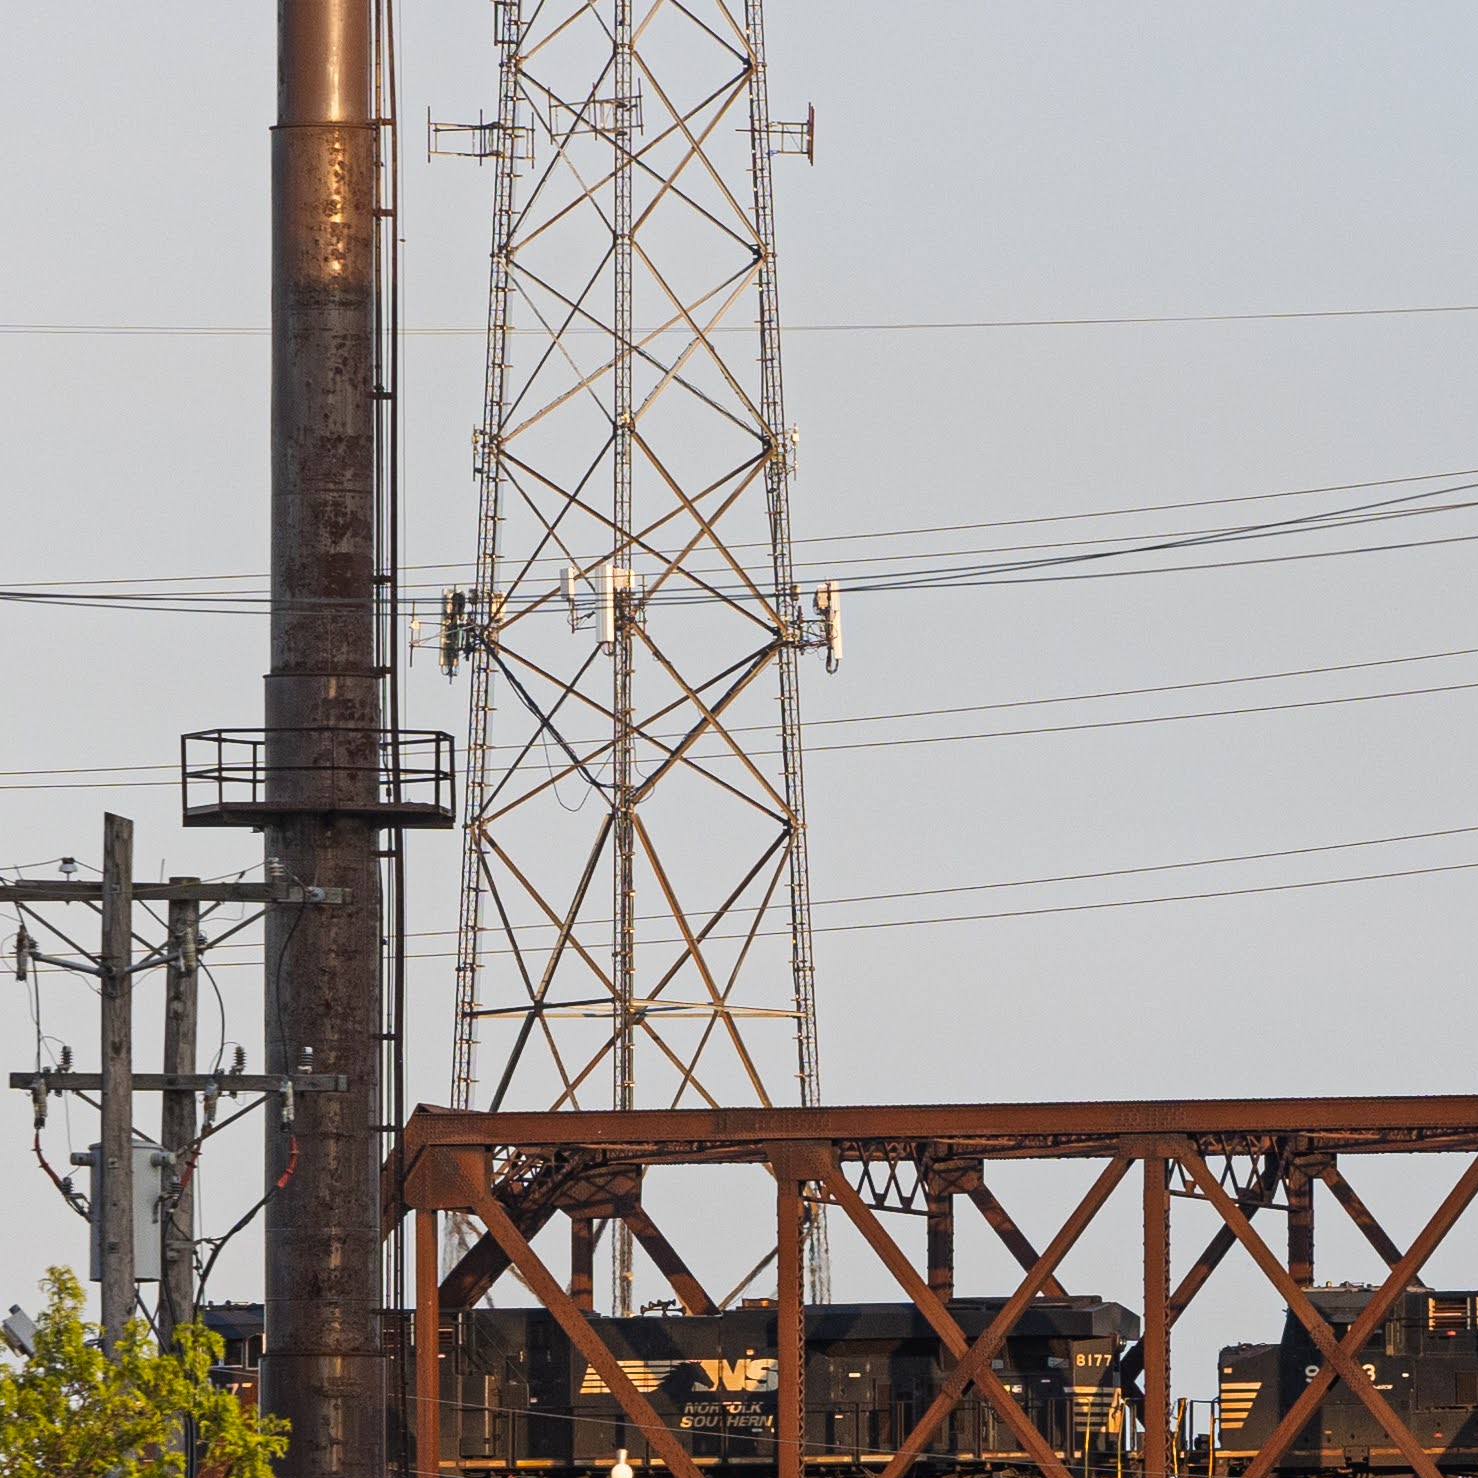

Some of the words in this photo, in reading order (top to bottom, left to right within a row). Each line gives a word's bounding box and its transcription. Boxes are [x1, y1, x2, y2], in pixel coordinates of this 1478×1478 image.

[1076, 1353, 1112, 1367] 8177
[692, 1359, 779, 1392] NS
[684, 1402, 764, 1413] NORFOLK
[680, 1415, 773, 1428] SOUTHERN
